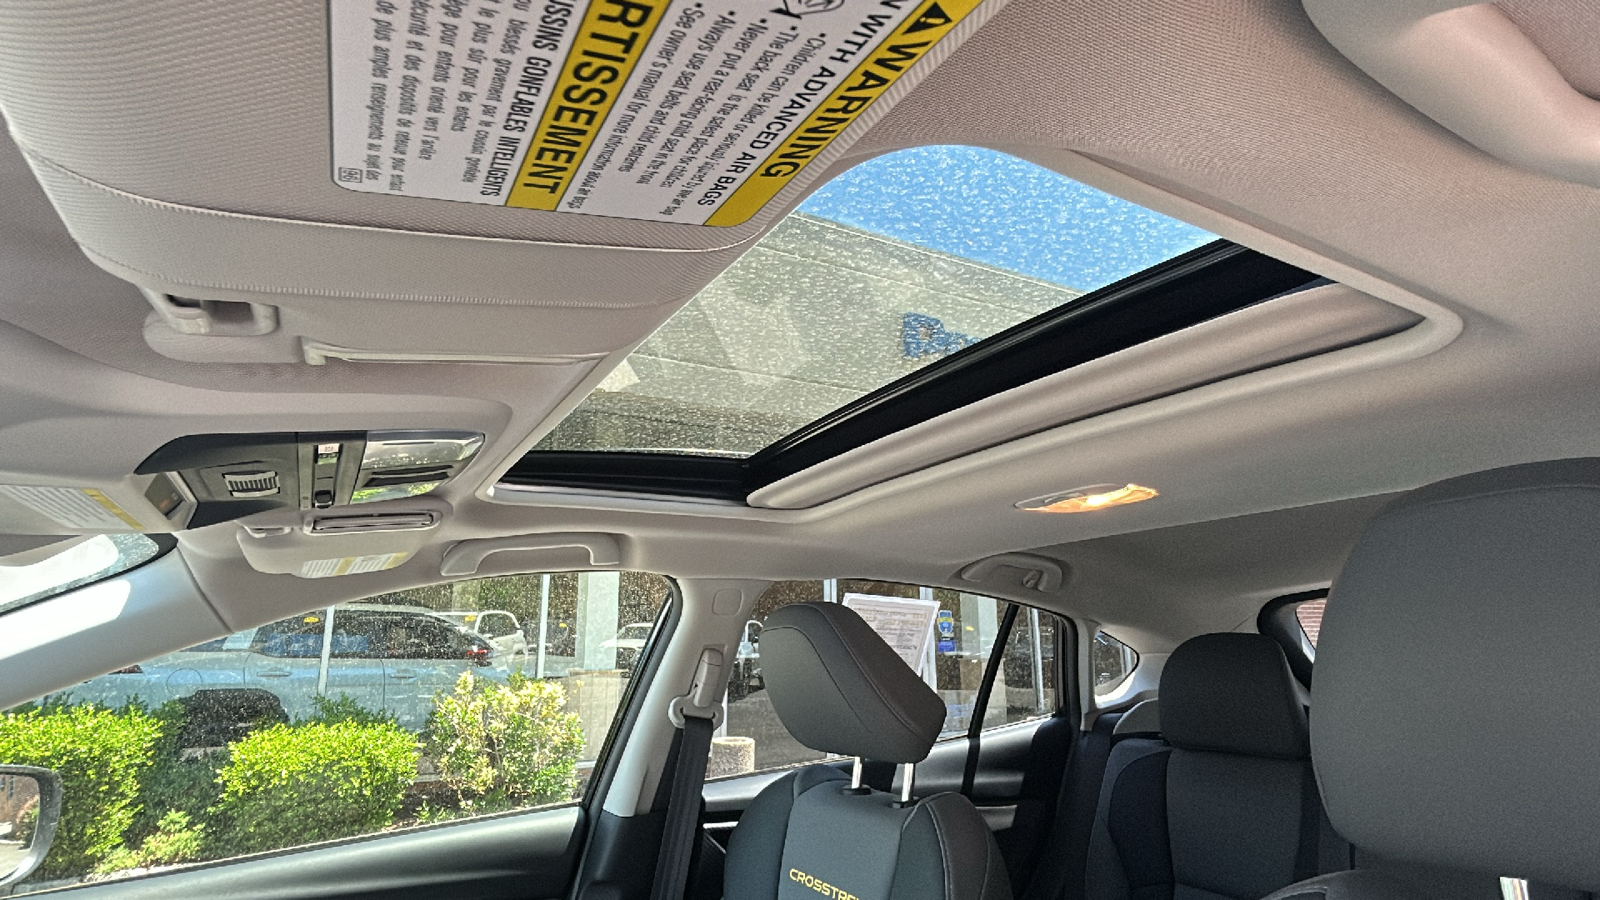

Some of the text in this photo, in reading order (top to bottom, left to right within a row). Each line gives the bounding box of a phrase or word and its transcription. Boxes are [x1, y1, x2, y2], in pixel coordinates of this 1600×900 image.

[376, 0, 398, 15] de
[478, 6, 500, 19] le
[675, 6, 705, 29] See
[408, 0, 434, 38] écurité
[371, 17, 396, 43] plus
[438, 21, 458, 48] pour
[471, 20, 494, 45] plus
[500, 18, 528, 56] blessés
[733, 22, 768, 54] Never
[406, 39, 425, 52] et
[467, 47, 487, 65] sûr
[652, 29, 687, 69] owner's
[369, 45, 393, 79] amples
[403, 54, 425, 72] des
[433, 50, 455, 83] enfants
[717, 51, 745, 71] put
[781, 37, 825, 76] Children
[461, 66, 479, 89] pour
[486, 57, 512, 103] gravement
[714, 69, 729, 77] a
[503, 56, 552, 133] GONFLABLES
[618, 14, 736, 173] Always use seat belts and child restraints
[633, 68, 663, 102] manual
[767, 76, 788, 92] can
[427, 86, 447, 114] orienté
[458, 90, 477, 104] les
[680, 76, 724, 120] rear-facing
[757, 92, 779, 103] be
[451, 105, 471, 132] enfants
[481, 103, 497, 118] par
[625, 101, 647, 115] for
[660, 31, 799, 188] The back seat is the safest place for children
[697, 14, 893, 206] WITH ADVANCED AIR BAGS
[740, 102, 769, 123] killed
[760, 40, 932, 178] WARNING
[397, 117, 414, 128] de
[423, 116, 438, 132] vers
[478, 119, 495, 128] le
[613, 113, 635, 134] more
[670, 119, 693, 138] child
[733, 123, 748, 133] or
[471, 129, 489, 155] coussin
[592, 134, 627, 171] information
[660, 137, 680, 153] seat
[705, 132, 740, 162] seriously
[390, 156, 405, 173] pour
[480, 135, 521, 197] INTELLIGENTS
[647, 159, 666, 171] the
[655, 152, 672, 160] in
[366, 169, 382, 181] des
[581, 170, 601, 189] about
[578, 187, 591, 196] air
[672, 197, 684, 206] air
[676, 189, 693, 199] the
[659, 205, 680, 216] bag
[789, 868, 859, 900] CROSSTRE
